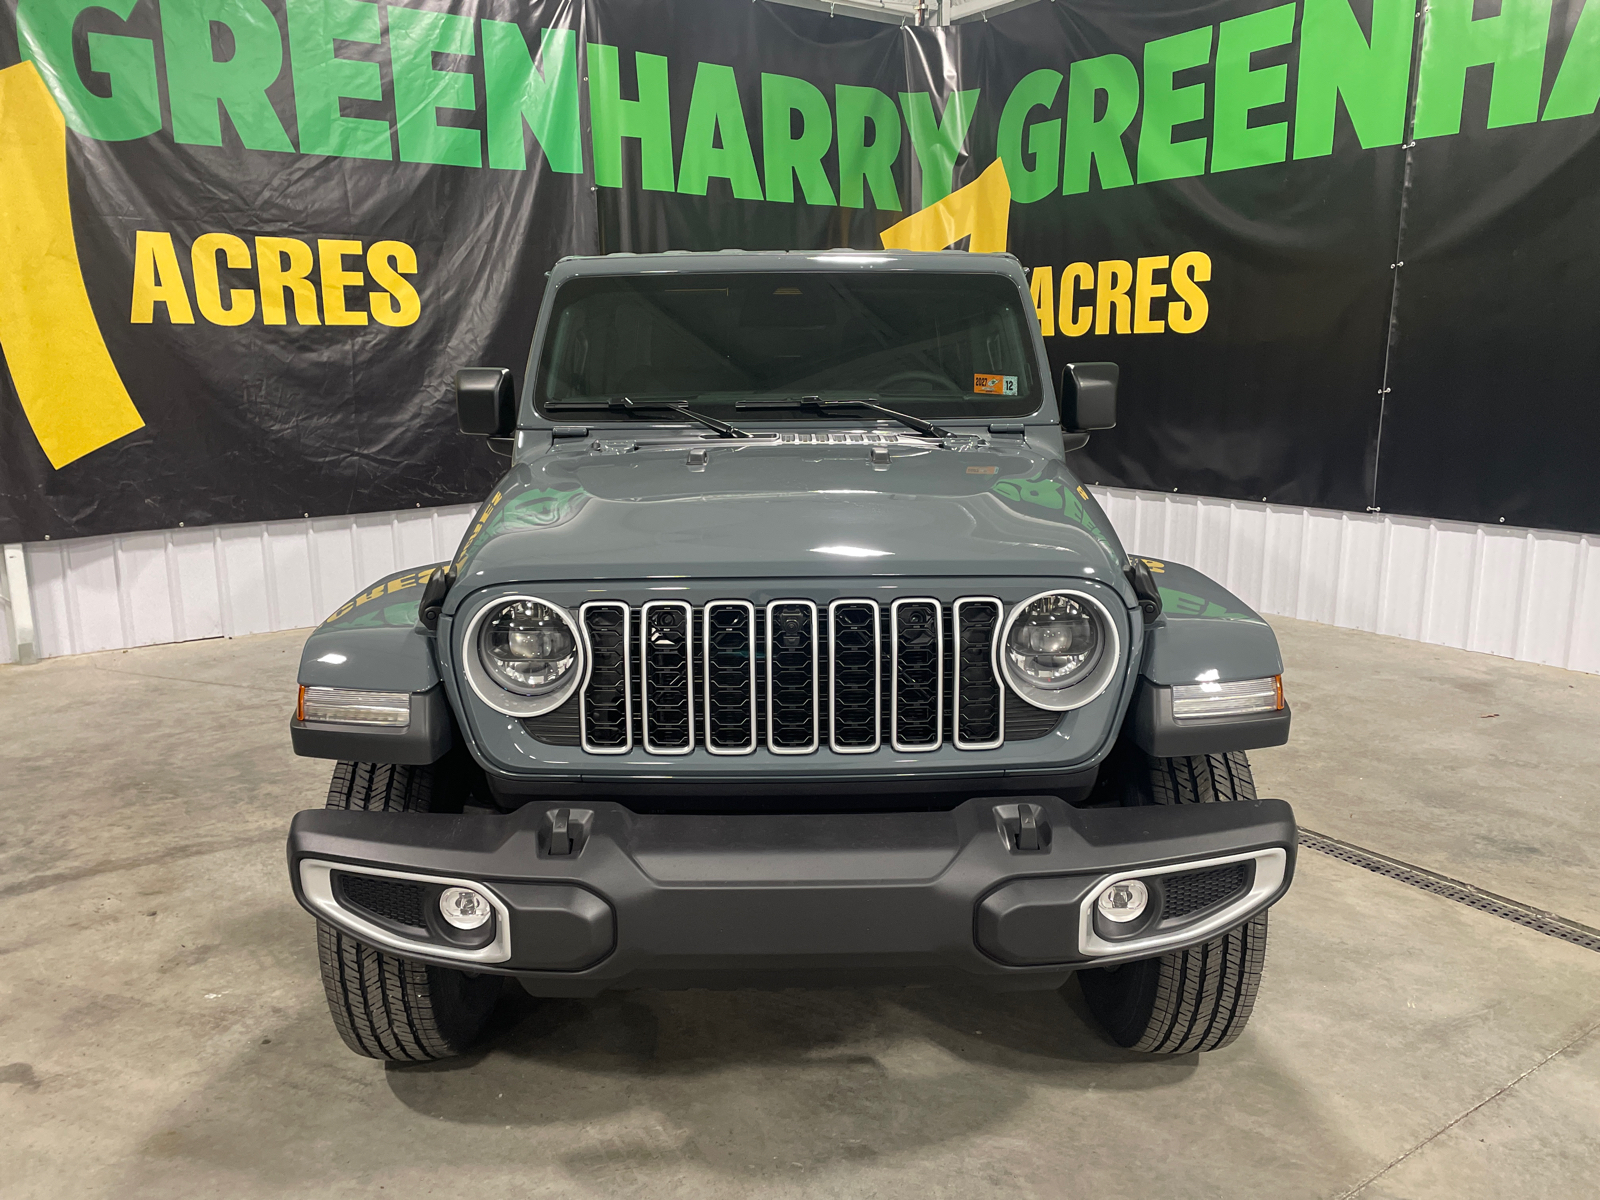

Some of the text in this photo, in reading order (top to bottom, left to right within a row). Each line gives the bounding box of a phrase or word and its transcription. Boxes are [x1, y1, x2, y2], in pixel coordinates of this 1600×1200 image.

[16, 0, 584, 174] GREEN
[587, 42, 981, 212] HARRY
[996, 0, 1416, 204] GREEN
[130, 230, 421, 327] ACRES
[1030, 250, 1212, 337] ACRES
[975, 377, 1014, 391] 2027 12
